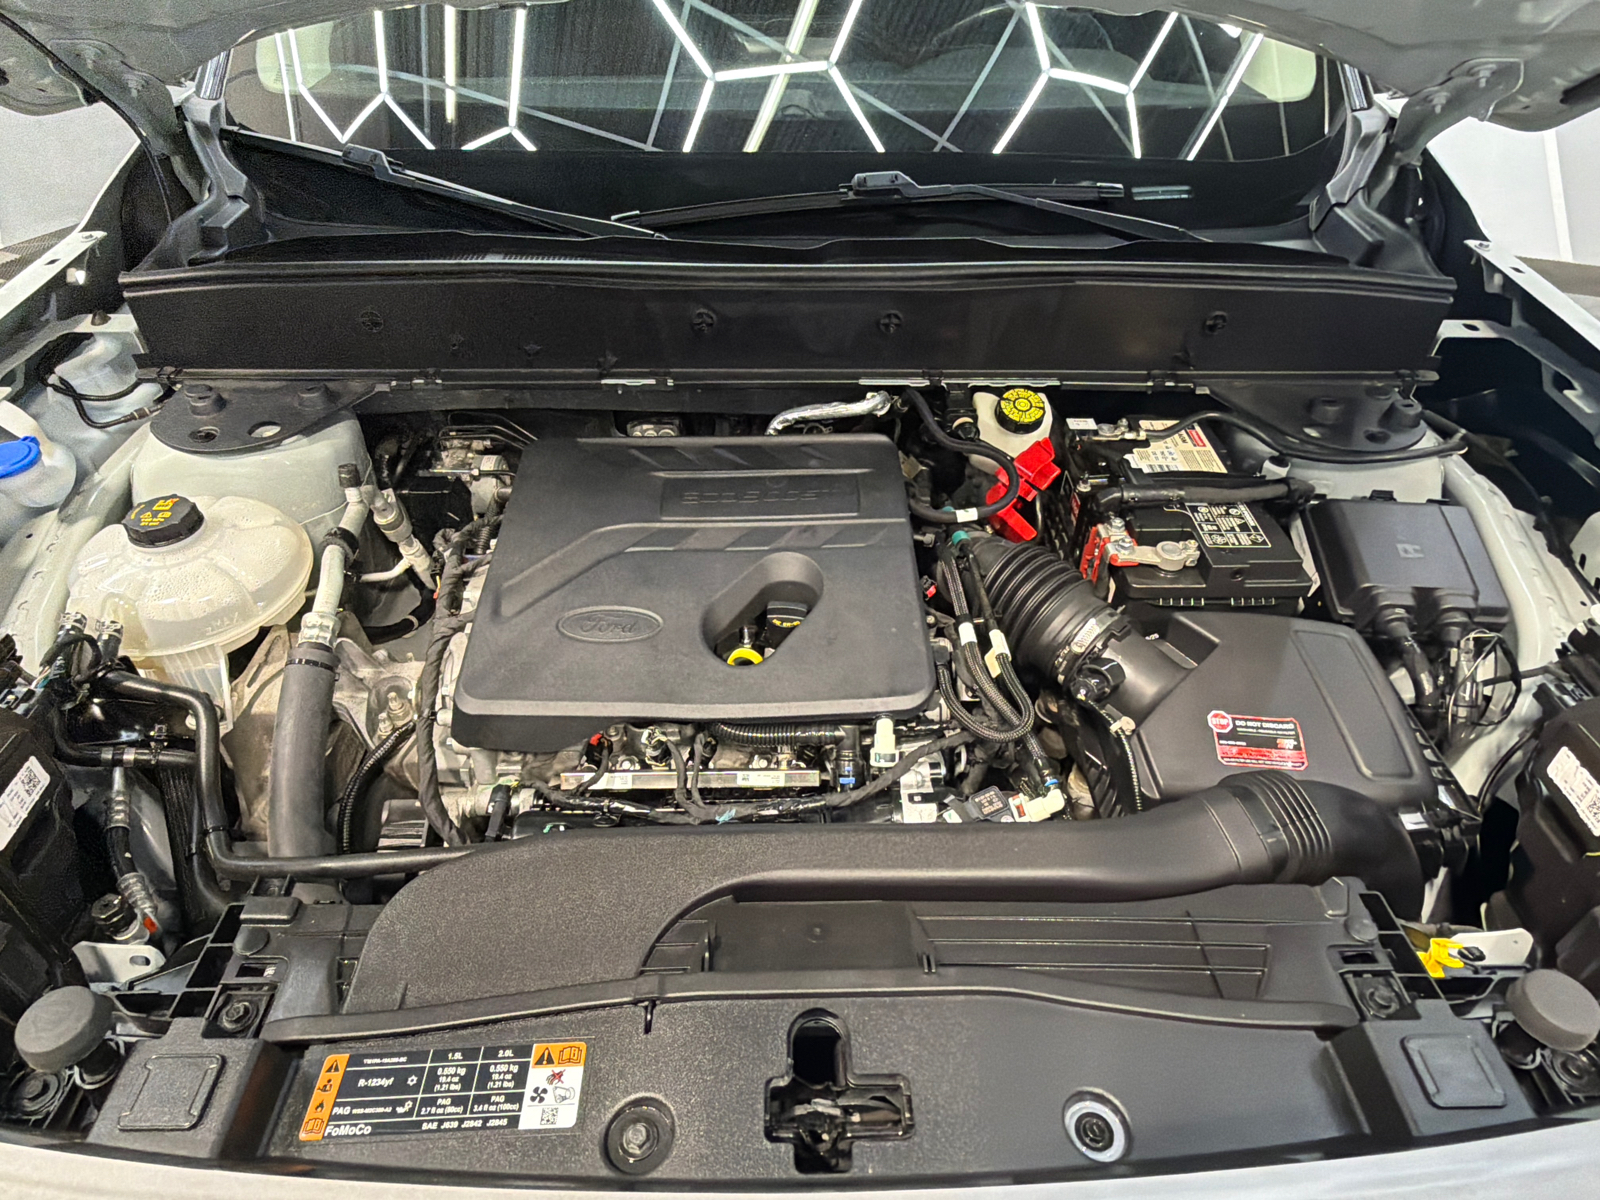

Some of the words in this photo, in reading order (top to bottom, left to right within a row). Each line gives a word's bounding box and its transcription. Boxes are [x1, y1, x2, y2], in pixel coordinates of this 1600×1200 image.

[580, 614, 638, 634] Ford
[1211, 717, 1229, 726] STOP
[1262, 722, 1295, 730] DISCARD
[448, 1052, 463, 1060] 1.5L
[498, 1049, 514, 1058] 2.0L
[437, 1067, 456, 1075] 0.550
[456, 1067, 466, 1076] kg
[489, 1064, 508, 1073] 0.550
[509, 1063, 519, 1073] kg
[357, 1077, 394, 1087] R-1234yf
[487, 1081, 502, 1090] (1.21
[502, 1080, 515, 1088] lbs)
[434, 1084, 448, 1092] (1.21
[449, 1083, 461, 1091] lbs)
[437, 1098, 452, 1106] PAG
[490, 1095, 505, 1103] PAG
[332, 1106, 351, 1115] PAG
[421, 1107, 430, 1115] 2.7
[497, 1103, 519, 1112] (100cc)
[422, 1122, 438, 1130] SAE
[440, 1121, 459, 1129] J639
[461, 1119, 483, 1128] J2842
[324, 1124, 372, 1137] FoMoCo
